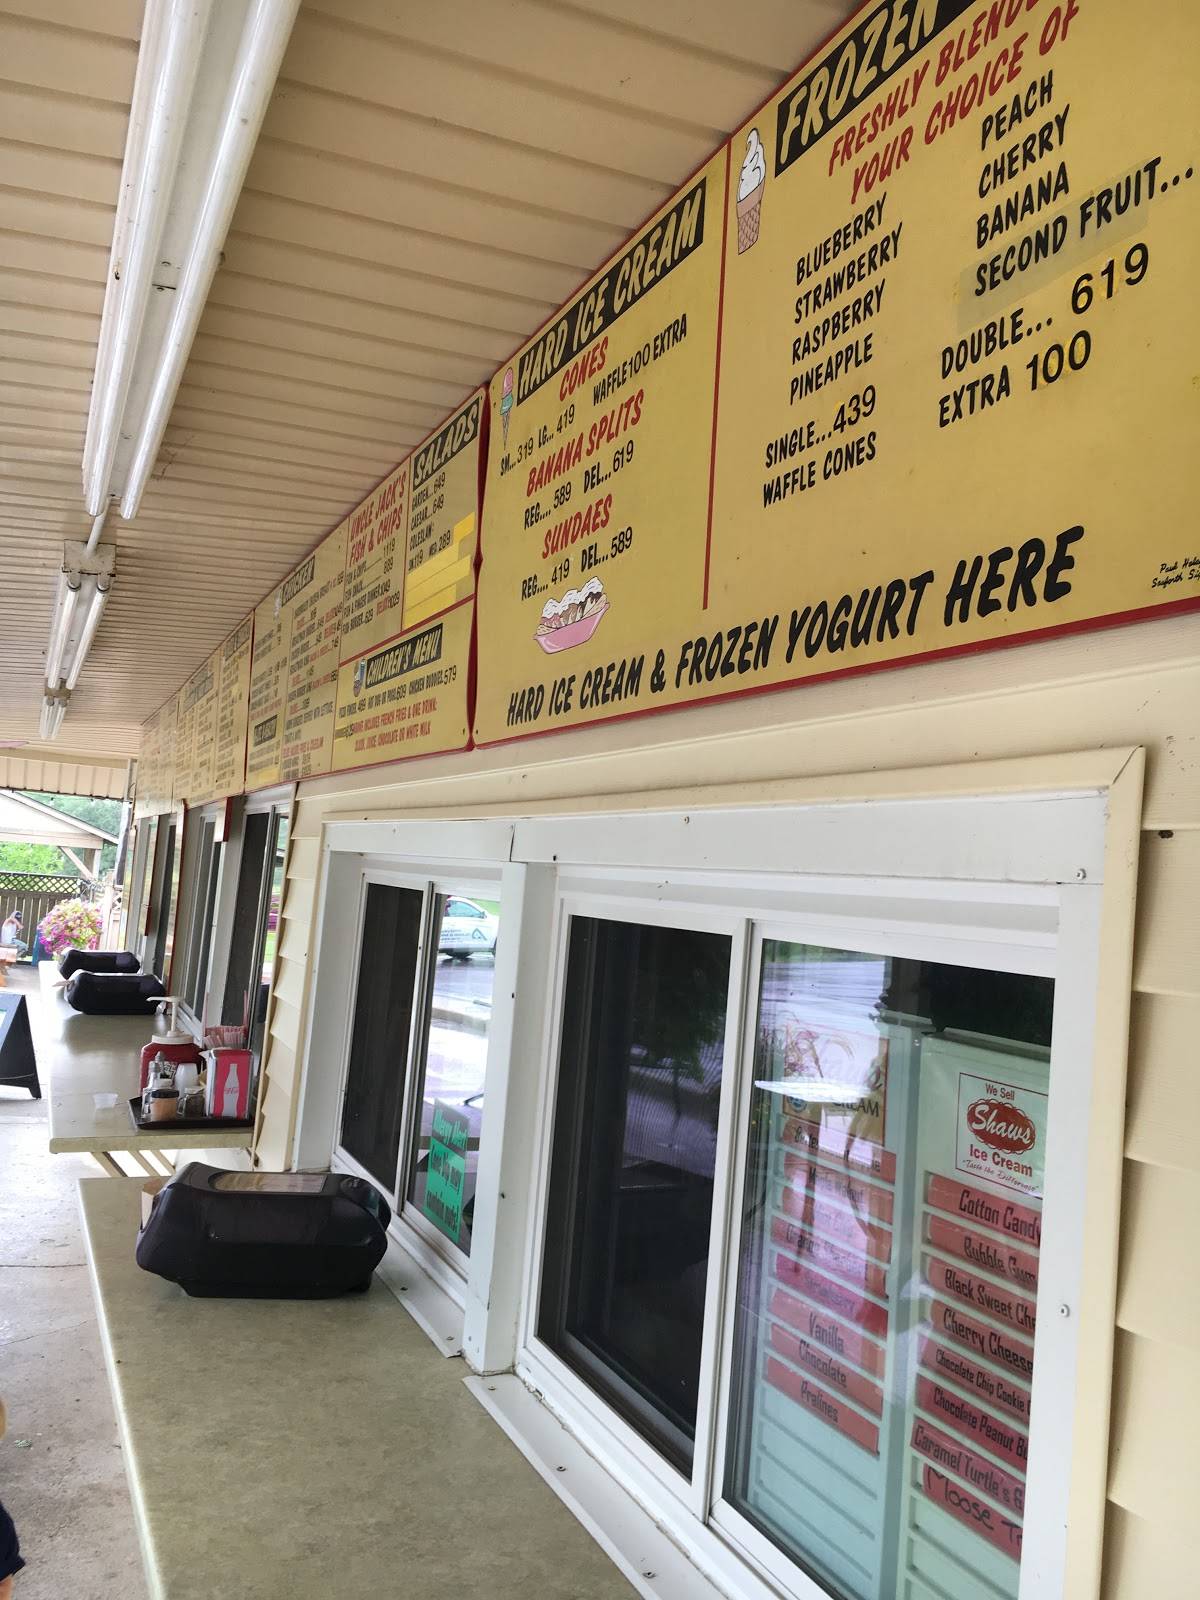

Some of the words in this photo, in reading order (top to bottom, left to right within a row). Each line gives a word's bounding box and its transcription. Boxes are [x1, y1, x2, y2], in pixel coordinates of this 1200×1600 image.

[780, 0, 938, 165] FROZEN
[829, 59, 930, 177] FRESHLY
[935, 0, 1038, 87] BLEND
[981, 69, 1053, 151] PEACH
[851, 126, 913, 205] YOUR
[924, 32, 1029, 145] CHOICE
[978, 104, 1070, 199] CHERRY
[976, 161, 1069, 249] BANANA
[796, 191, 887, 286] BLUEBERRY
[974, 214, 1068, 296] SECOND
[518, 319, 568, 400] HARD
[572, 278, 609, 352] ICE
[613, 187, 702, 314] CREAM
[794, 221, 902, 324] STRAWBERRY
[1071, 242, 1149, 315] 619
[653, 313, 687, 362] EXTRA
[792, 278, 885, 365] RASPBERRY
[559, 336, 608, 402] CONES
[790, 332, 873, 406] PINEAPPLE
[938, 365, 1011, 428] EXTRA
[1026, 330, 1091, 391] 100
[414, 403, 477, 486] SALADS
[526, 433, 584, 498] BANANA
[586, 388, 644, 457] SPLITS
[556, 404, 575, 434] 419
[553, 481, 572, 508] 589
[763, 461, 816, 508] WAFFLE
[823, 431, 876, 480] CONES
[377, 503, 402, 545] CHIPS
[542, 493, 612, 559] SUNDAES
[551, 558, 570, 585] 419
[367, 643, 412, 685] CHILDREN'S
[412, 629, 441, 667] MENU
[506, 681, 545, 727] HARD
[548, 673, 576, 717] ICE
[580, 654, 645, 709] CREAM
[649, 648, 666, 689] &
[675, 614, 779, 689] FROZEN
[786, 570, 934, 663] YOGURT
[943, 525, 1085, 627] HERE
[444, 664, 457, 685] 579
[972, 1103, 1031, 1145] Shaws
[986, 1083, 997, 1096] We
[1000, 1087, 1015, 1101] Sell
[970, 1144, 988, 1161] Ice
[992, 1151, 1033, 1177] Cream
[959, 1189, 999, 1224] Cotton
[964, 1236, 1006, 1274] Bubble
[945, 1268, 974, 1301] Black
[977, 1284, 1012, 1320] Sweet
[799, 1338, 847, 1388] Chocolate
[808, 1312, 844, 1353] Vanilla
[943, 1307, 985, 1354] Cherry
[801, 1380, 838, 1425] Pralines
[936, 1348, 974, 1384] Chocolate
[976, 1370, 995, 1396] Chip
[996, 1382, 1025, 1413] Cookie
[914, 1425, 962, 1470] Caramel
[934, 1386, 977, 1430] Chocolate
[979, 1415, 1014, 1452] Peanut
[927, 1466, 994, 1532] Moose
